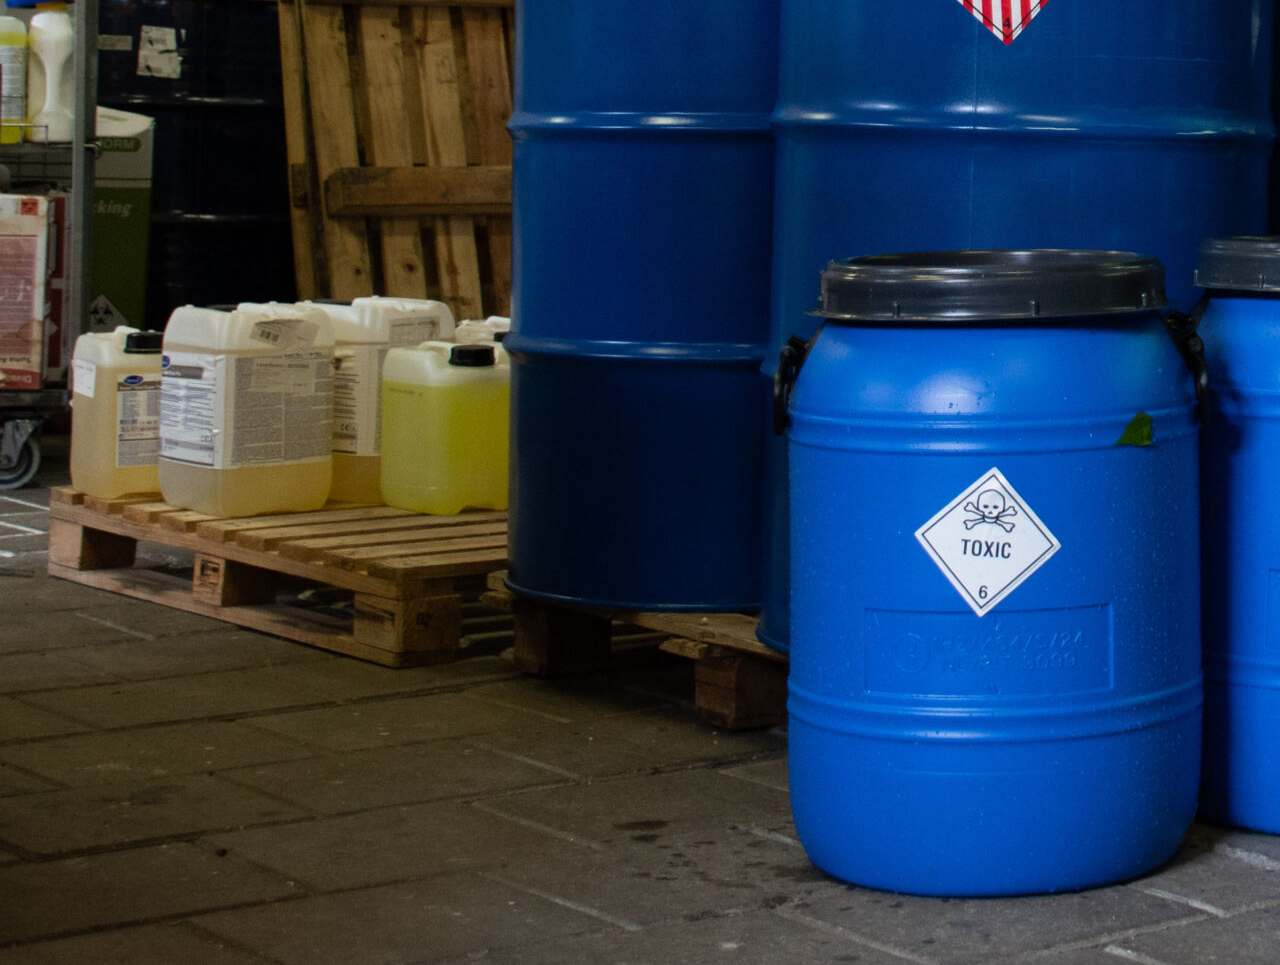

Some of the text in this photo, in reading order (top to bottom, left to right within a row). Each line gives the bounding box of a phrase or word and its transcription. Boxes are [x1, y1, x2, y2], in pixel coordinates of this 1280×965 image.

[1002, 17, 1010, 29] 4
[100, 138, 135, 149] ORM
[961, 538, 1012, 559] TOXIC
[978, 585, 988, 599] 6
